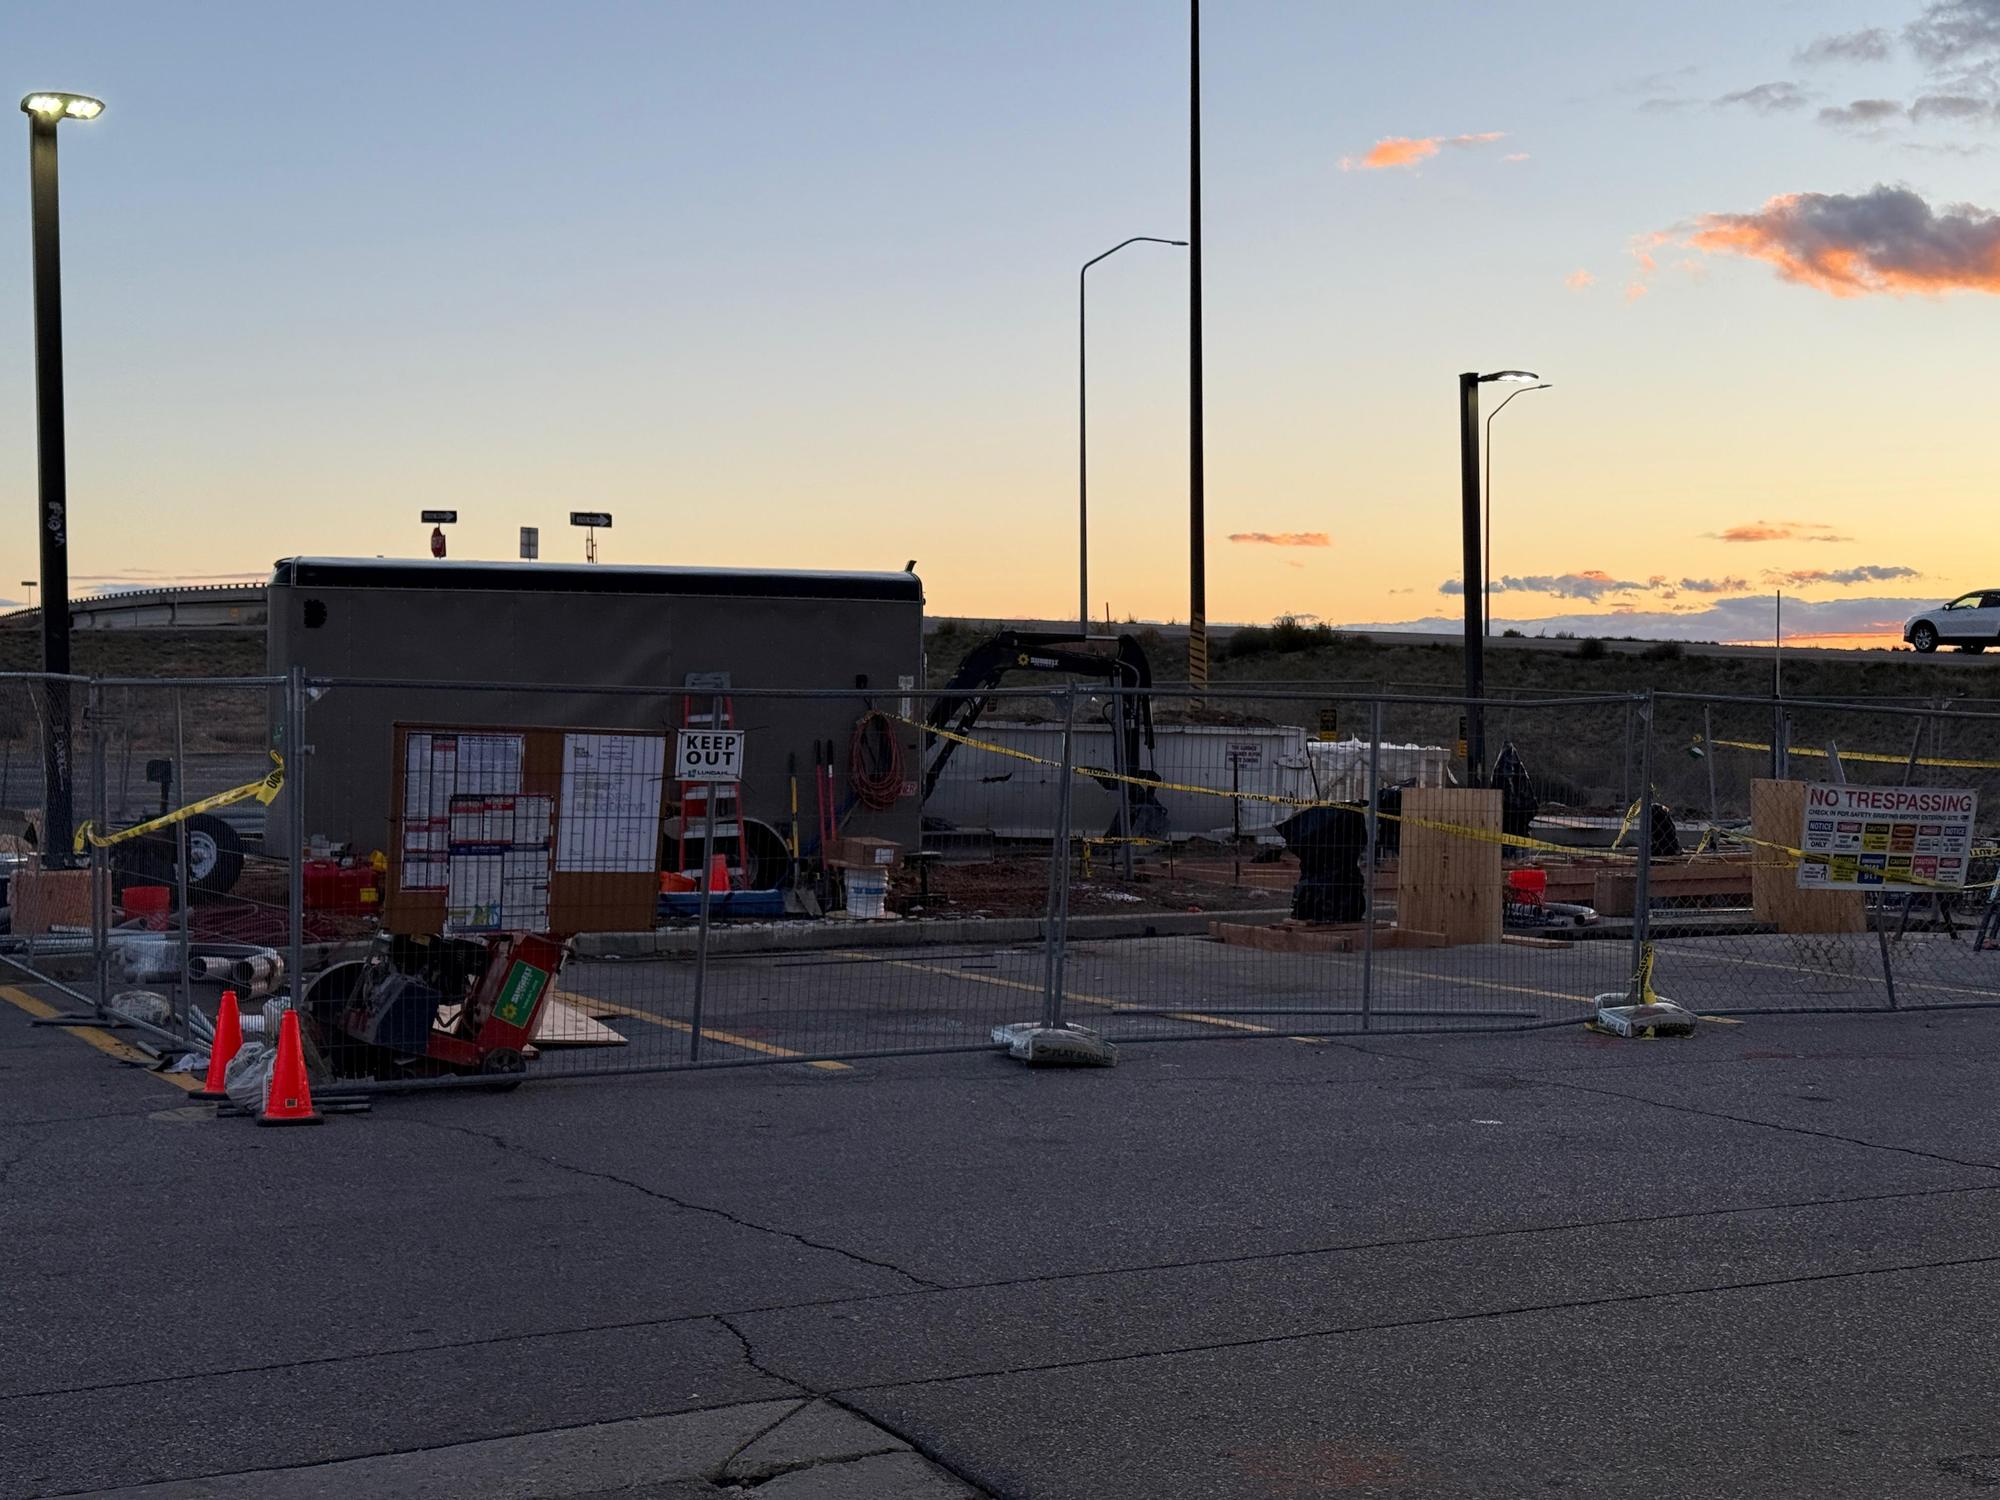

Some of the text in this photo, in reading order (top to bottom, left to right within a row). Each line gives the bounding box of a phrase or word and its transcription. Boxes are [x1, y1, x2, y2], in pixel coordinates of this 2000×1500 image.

[687, 735, 736, 750] KEEP
[686, 751, 735, 765] OUT
[1278, 797, 1320, 806] CAUTION
[1810, 789, 1972, 812] NO TRESPASSING
[1809, 821, 1833, 832] NOTICE
[1969, 849, 1999, 857] CAUTI
